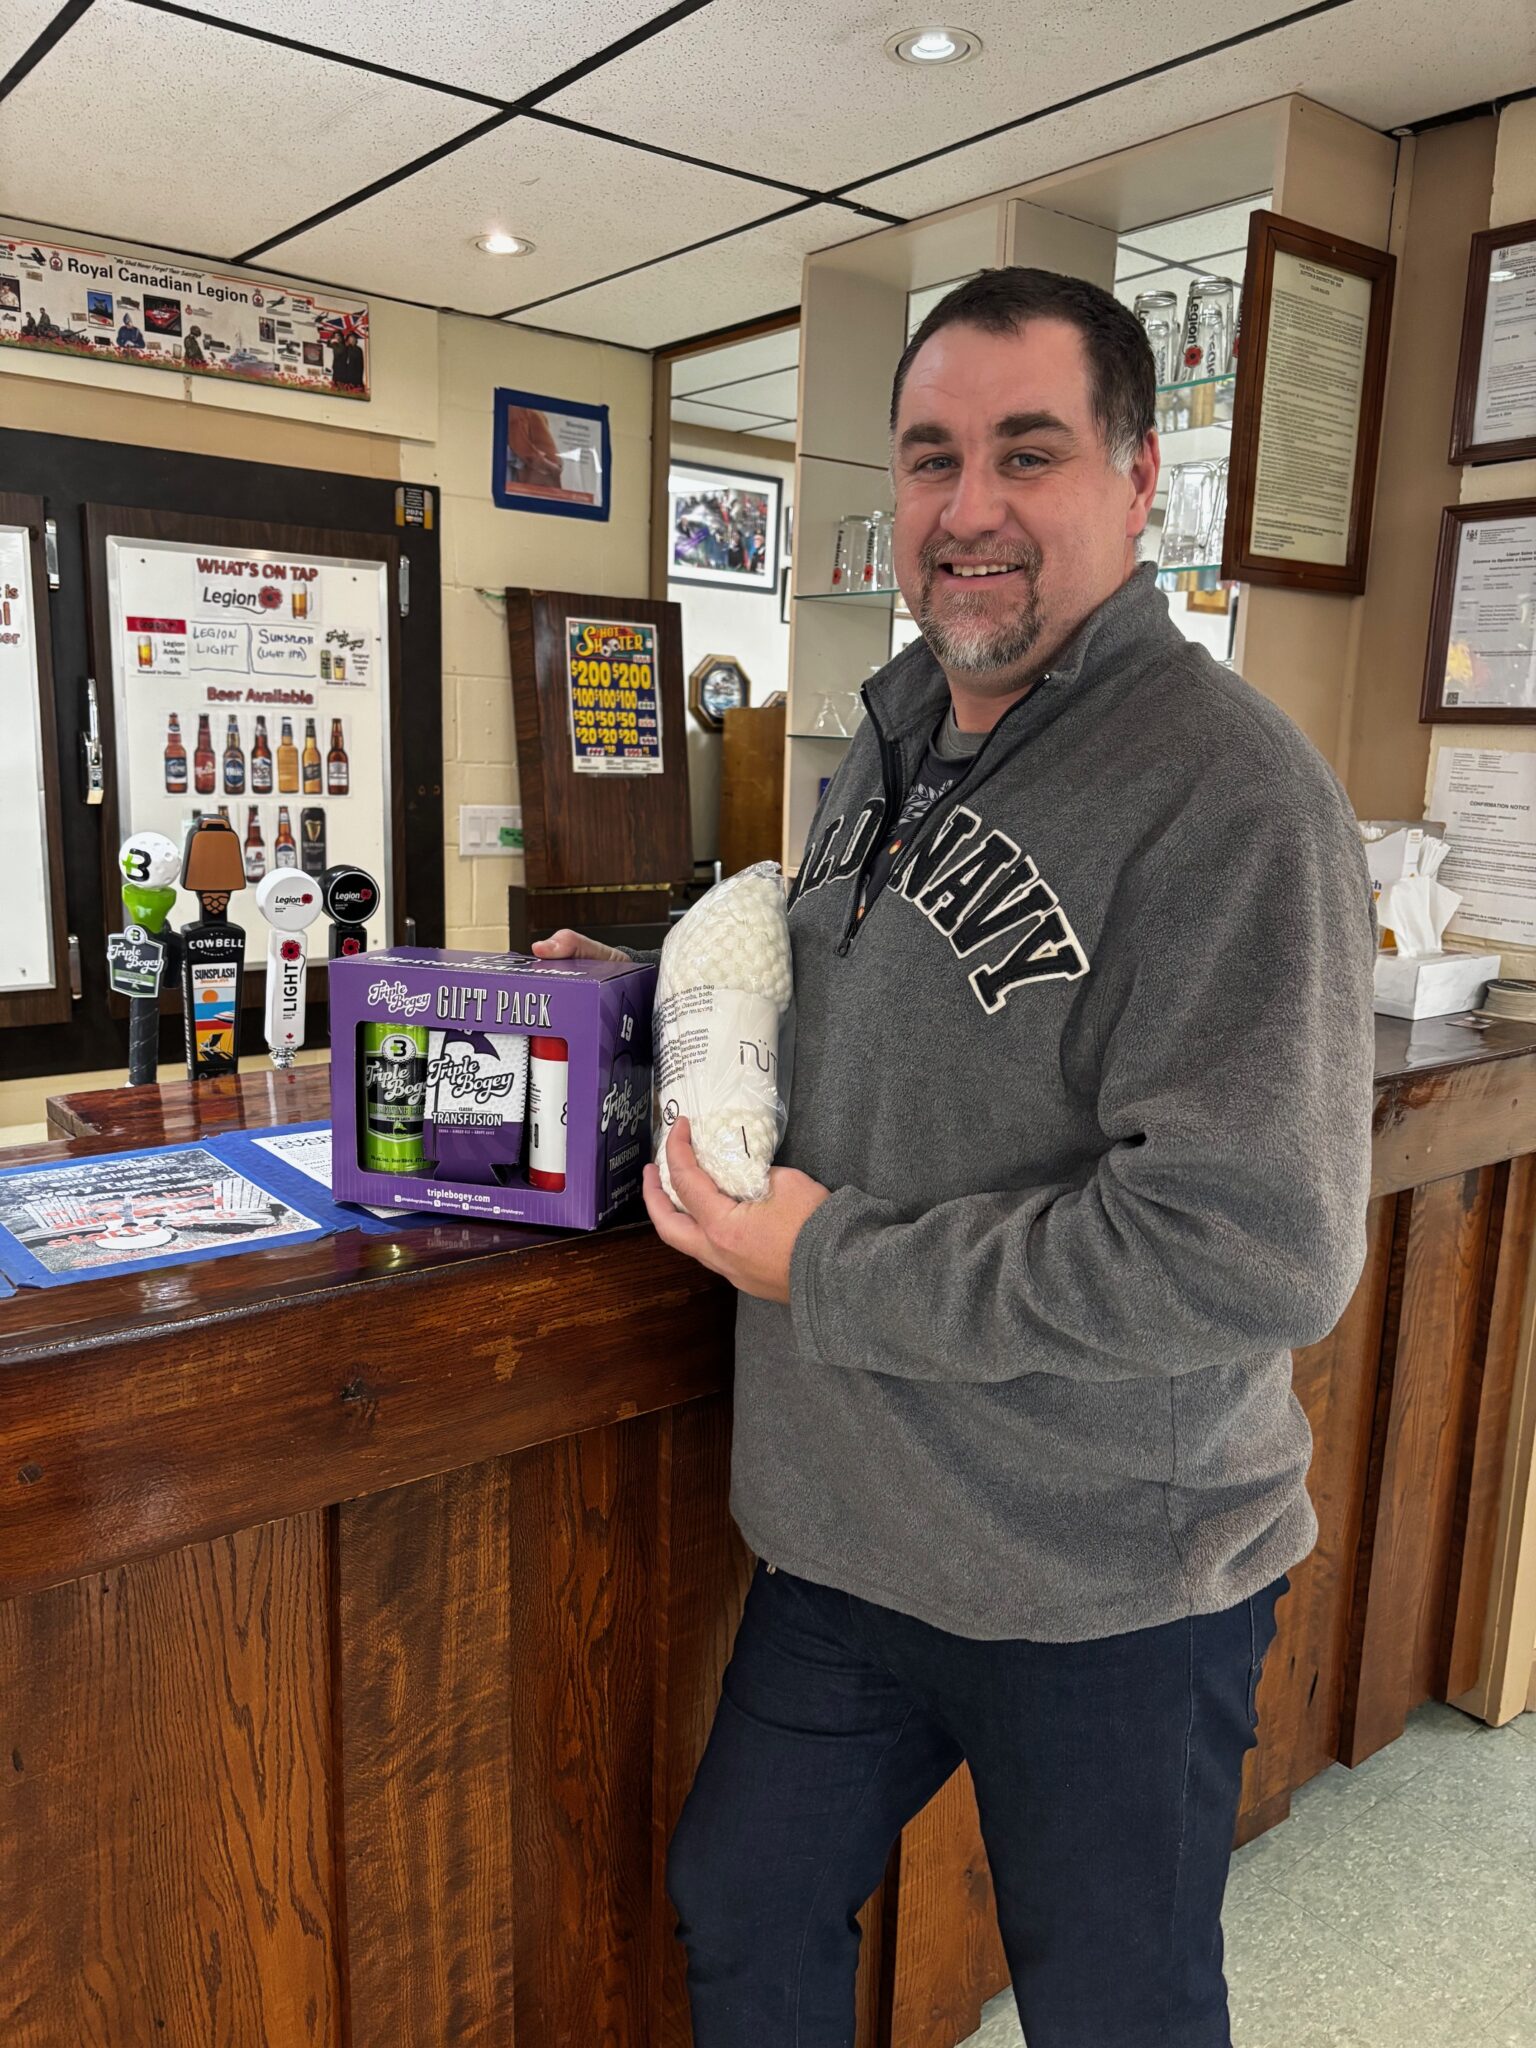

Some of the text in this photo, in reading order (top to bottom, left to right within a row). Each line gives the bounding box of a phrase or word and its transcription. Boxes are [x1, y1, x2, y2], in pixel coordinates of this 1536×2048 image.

[67, 257, 249, 304] Royal Canadian Legion
[1187, 295, 1203, 345] Legion
[196, 557, 319, 582] WHAT'S ON TAP
[5, 583, 19, 599] is
[203, 586, 257, 608] Legion
[163, 640, 186, 648] Legion
[192, 626, 238, 640] LEGION
[163, 648, 186, 656] Amber
[196, 643, 239, 656] LIGHT
[571, 659, 652, 690] $200 $200
[207, 686, 314, 705] Beer Available
[572, 687, 637, 710] $100 $100 $100
[574, 710, 637, 728] $50 $50 $50
[576, 727, 639, 745] $20 $20 $20
[1469, 800, 1509, 809] CONFIRMATION
[275, 896, 301, 905] Legion
[335, 891, 361, 902] Legion
[887, 804, 1091, 1015] NAVY
[106, 942, 142, 960] Triple
[188, 938, 244, 950] COWBELL
[125, 956, 163, 974] Bogey
[194, 967, 236, 980] SUNSPLASH
[368, 955, 588, 976] #BetterHitAnother
[283, 964, 298, 1012] LIGHT
[368, 979, 408, 1006] Triple
[388, 992, 431, 1017] Bogey
[436, 985, 553, 1027] GIFT PACK
[620, 1013, 634, 1042] 19
[366, 1060, 410, 1088] Triple
[427, 1053, 480, 1087] Triple
[451, 1072, 515, 1104] Bogey
[601, 1078, 633, 1134] Triple
[617, 1087, 651, 1137] Bogey
[432, 1112, 503, 1126] TRANSFUSION
[608, 1143, 641, 1172] TRANSFUSION
[8, 1157, 177, 1186] Strictly Acoustic
[49, 1168, 151, 1187] song circle
[24, 1170, 195, 1200] every Tuesday
[161, 1185, 218, 1199] back
[427, 1188, 491, 1203] triplebogey.com
[48, 1223, 160, 1248] starts
